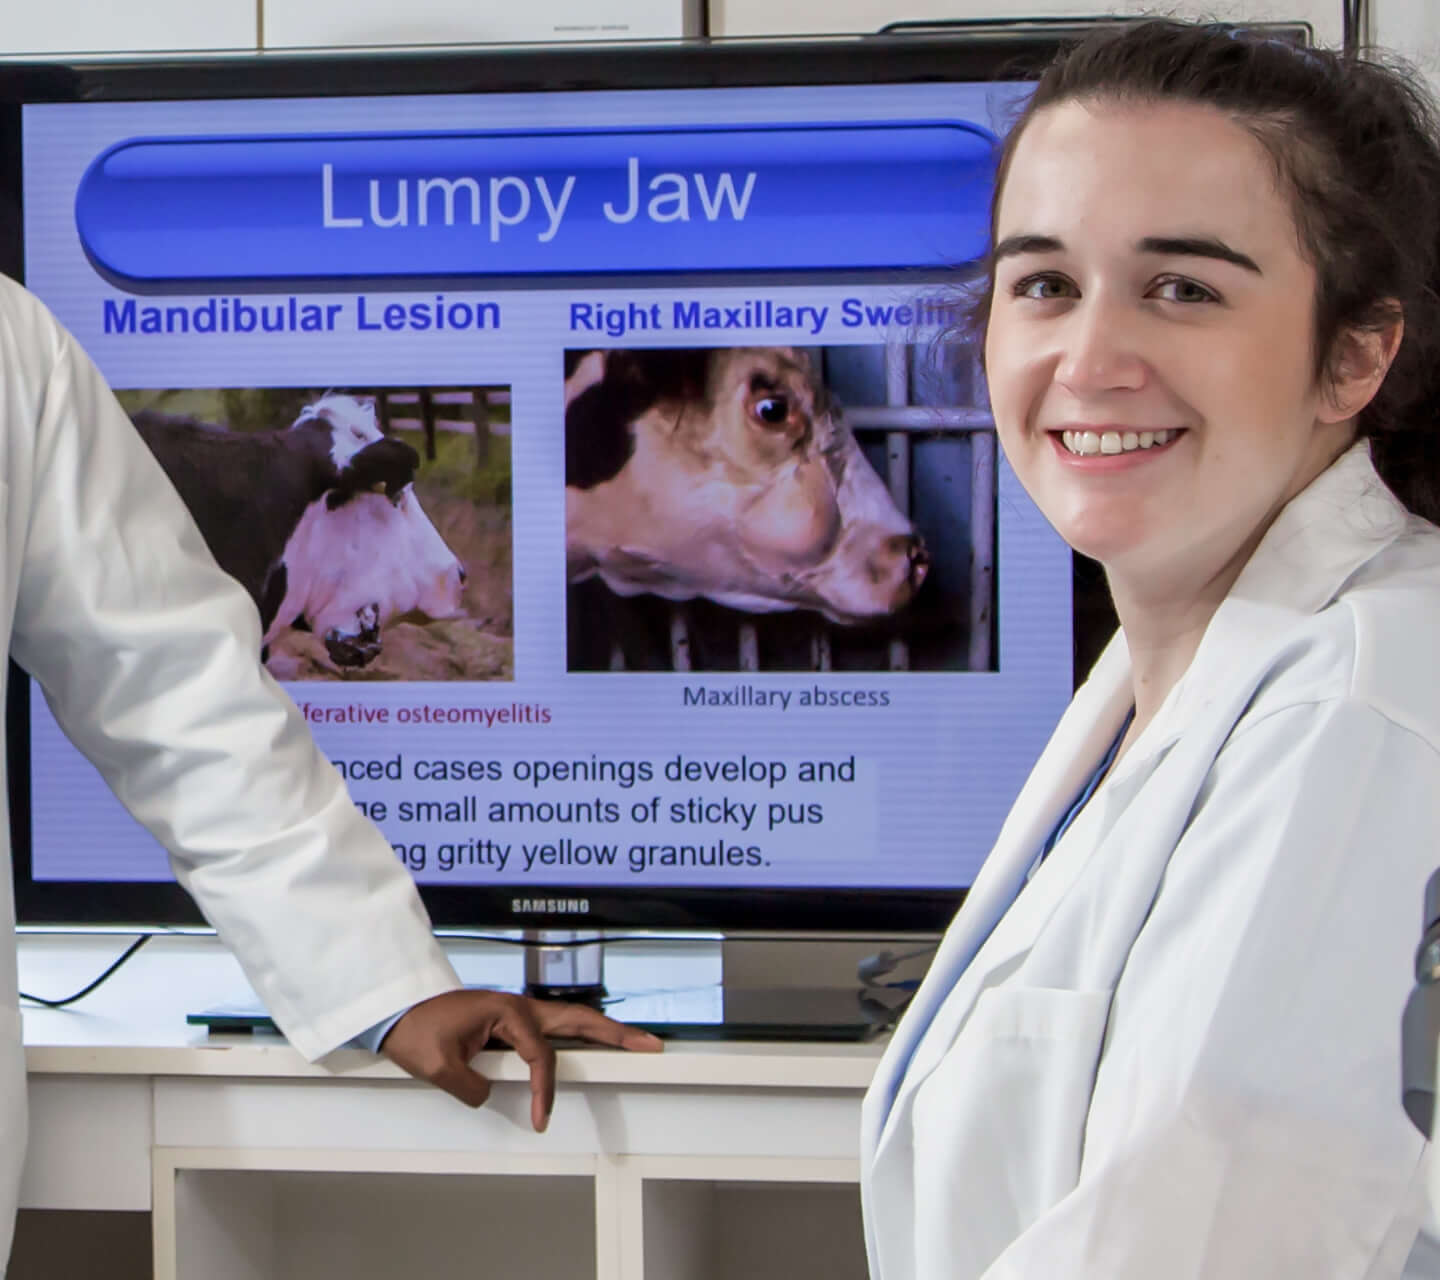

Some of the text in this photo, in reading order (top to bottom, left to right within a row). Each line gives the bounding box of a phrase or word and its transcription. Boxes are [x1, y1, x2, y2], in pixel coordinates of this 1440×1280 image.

[322, 157, 756, 243] Lumpy Jaw
[103, 295, 500, 334] Mandibular Lesion
[569, 302, 661, 337] Right
[673, 299, 829, 334] Maxillary
[297, 703, 552, 728] ferative osteomyelitis
[683, 685, 890, 710] Maxillary abscess
[413, 760, 503, 781] cases
[513, 754, 654, 789] openings
[664, 754, 787, 790] develop
[797, 754, 855, 782] and
[397, 795, 477, 823] small
[487, 797, 621, 824] amounts
[630, 796, 661, 824] of
[669, 796, 757, 832] sticky
[768, 803, 824, 832] pus
[437, 837, 512, 873] gritty
[521, 838, 619, 873] yellow
[628, 839, 771, 874] granules.
[511, 898, 590, 914] SAMSUNG
